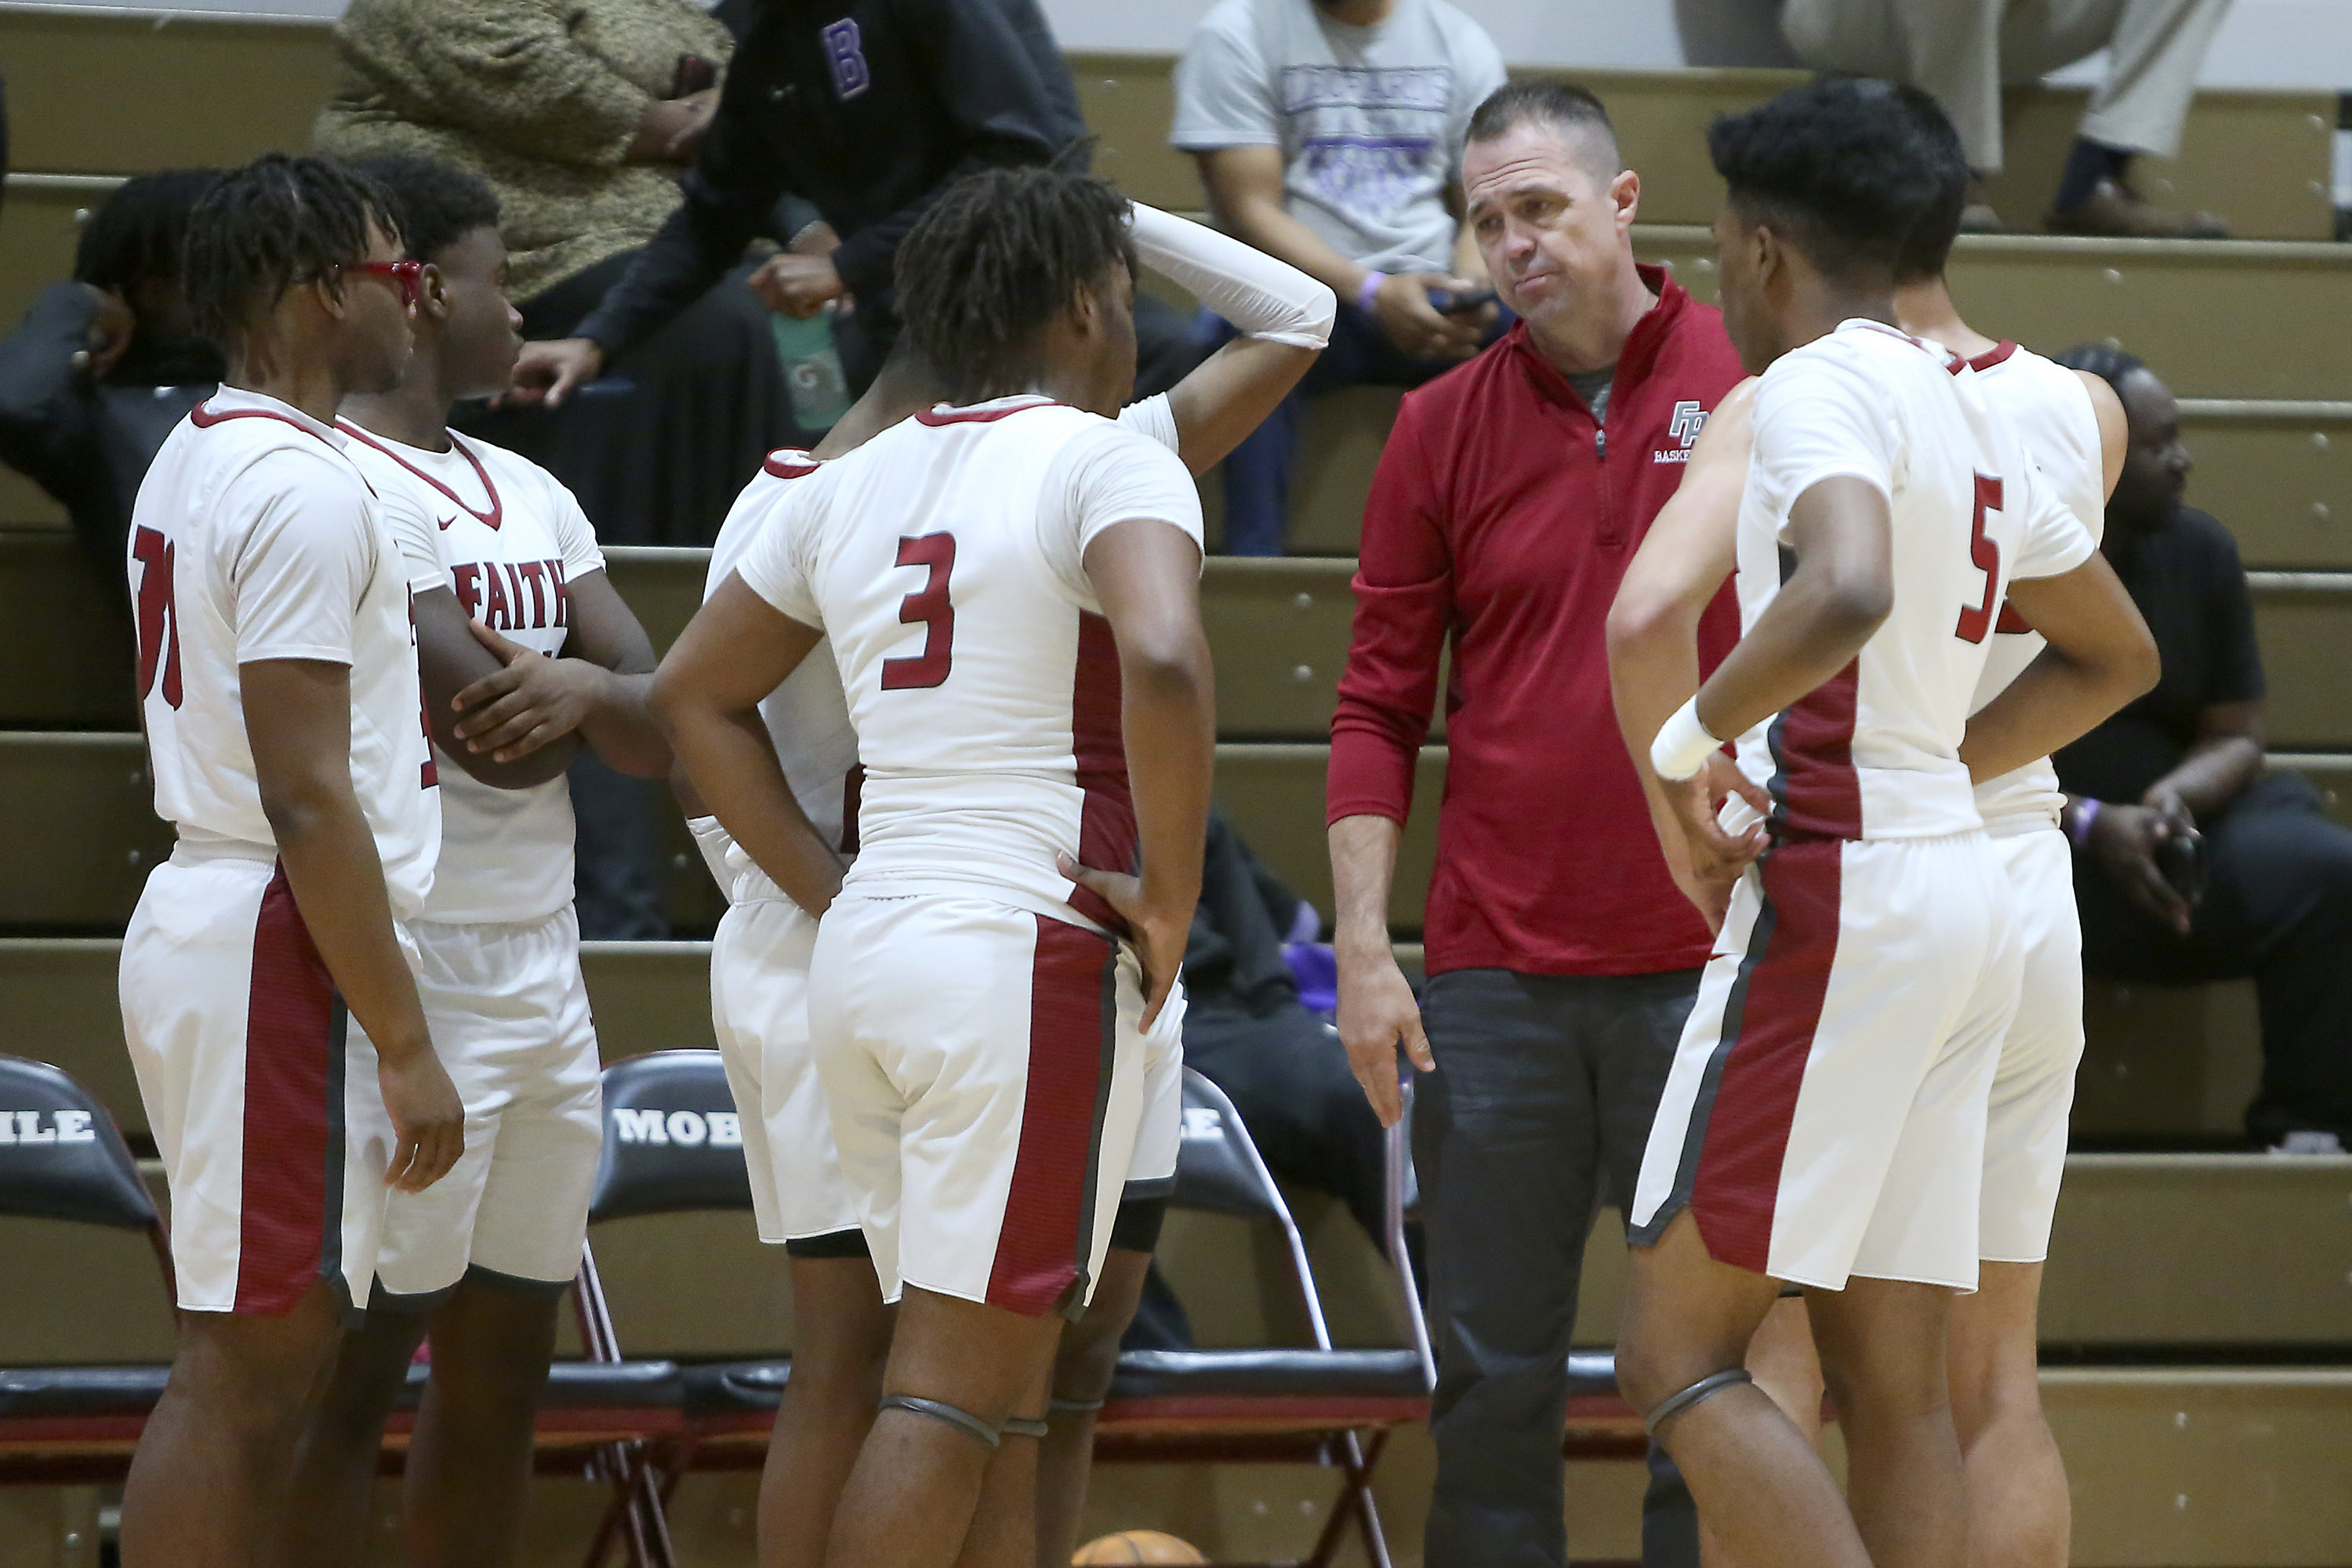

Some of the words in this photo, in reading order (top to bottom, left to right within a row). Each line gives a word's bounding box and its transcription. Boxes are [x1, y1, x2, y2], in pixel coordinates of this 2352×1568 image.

[822, 17, 869, 98] B
[450, 559, 567, 630] FAITH
[1955, 468, 2004, 645] 5
[880, 530, 956, 691] 3
[612, 1108, 743, 1145] MOB
[1181, 1107, 1223, 1139] E
